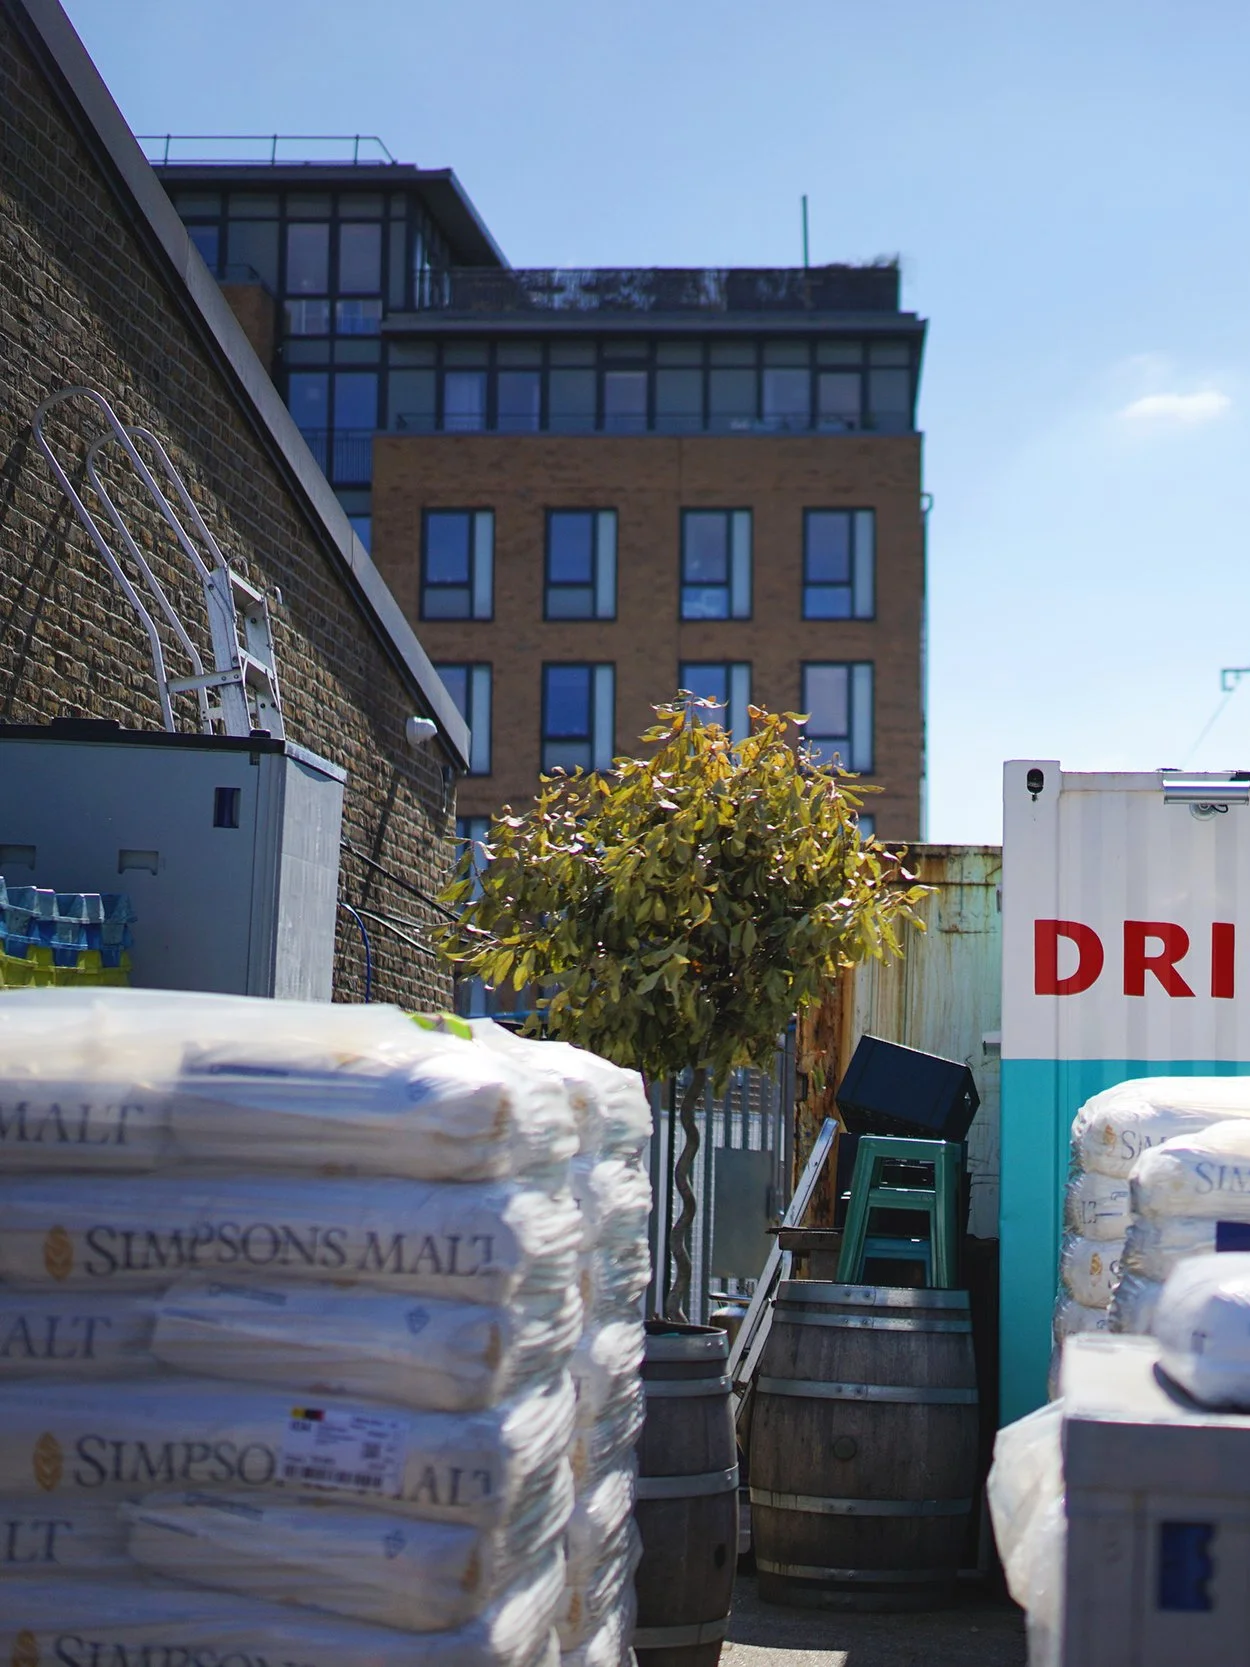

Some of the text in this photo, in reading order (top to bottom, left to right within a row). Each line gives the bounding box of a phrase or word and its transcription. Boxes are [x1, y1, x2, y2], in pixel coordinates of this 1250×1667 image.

[84, 1222, 497, 1277] SIMPSONS MALT
[73, 1434, 285, 1488] SIMPSO
